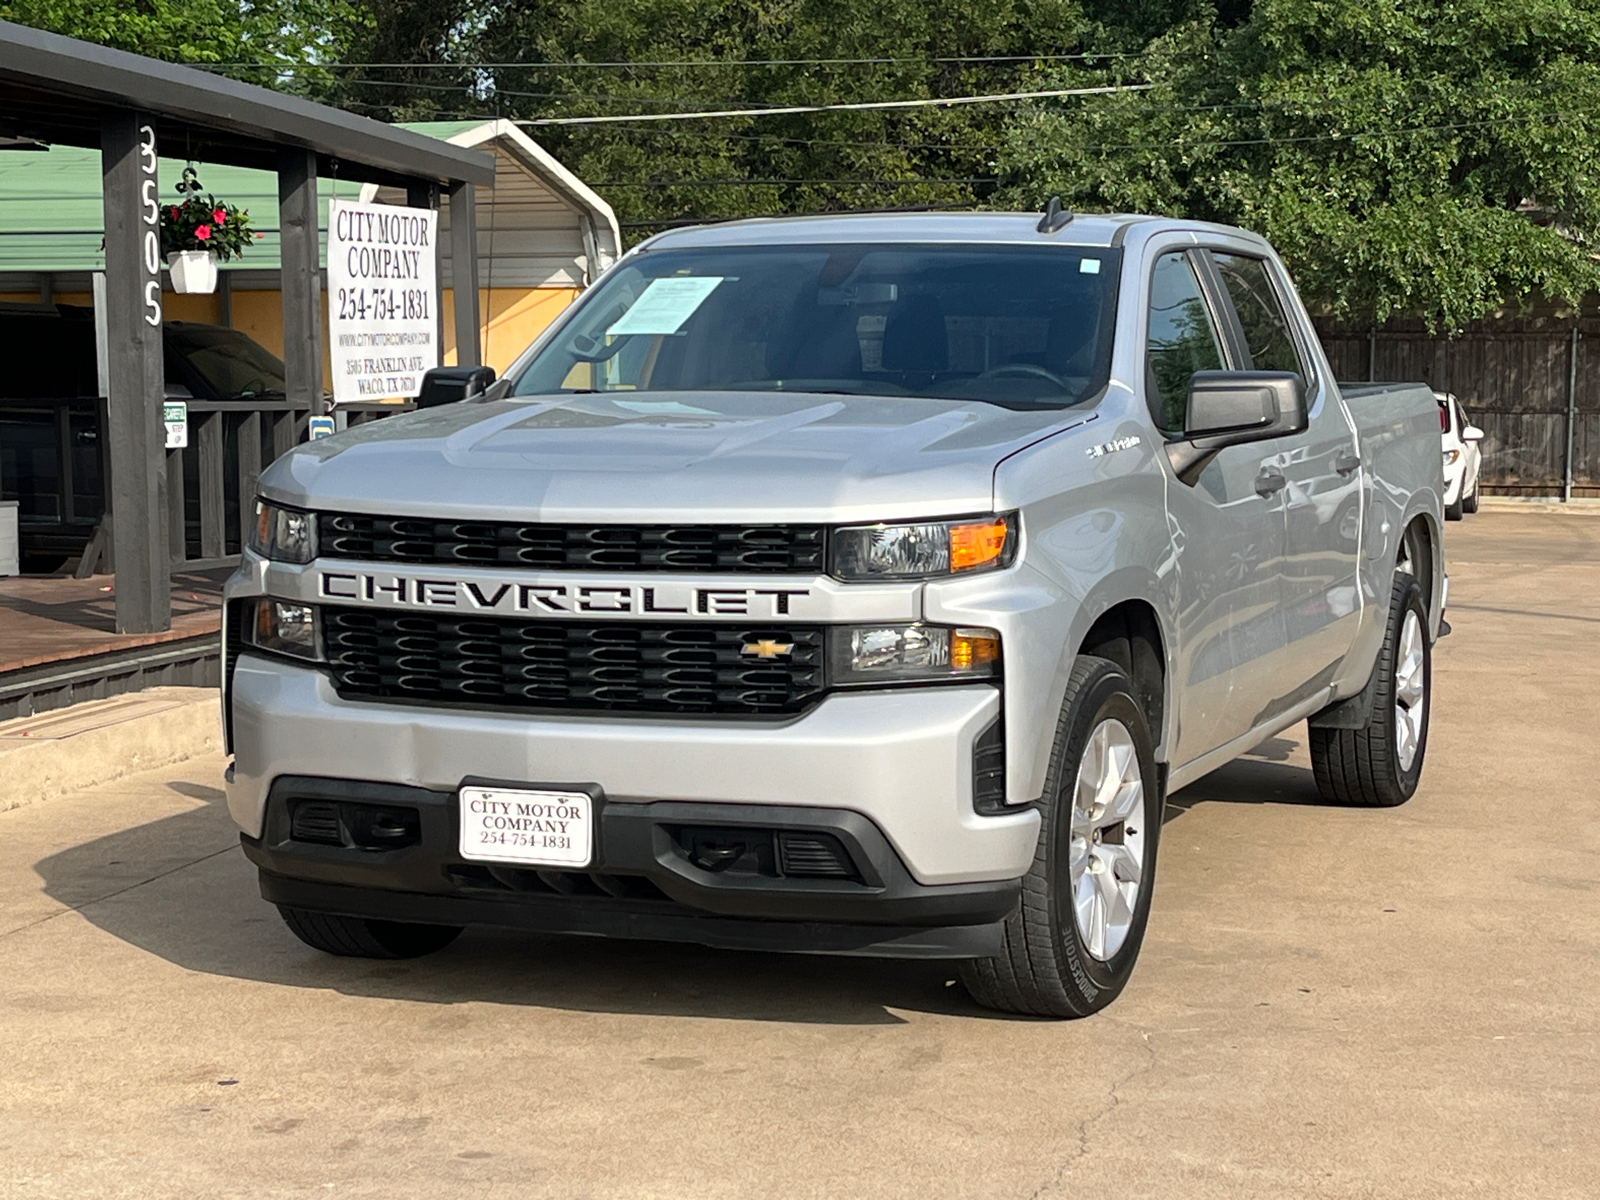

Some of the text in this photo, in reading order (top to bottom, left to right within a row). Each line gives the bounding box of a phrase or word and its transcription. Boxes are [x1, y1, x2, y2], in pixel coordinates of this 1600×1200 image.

[139, 125, 161, 326] 3505
[337, 209, 429, 247] CITY MOTOR
[347, 246, 421, 280] COMPANY
[338, 287, 429, 320] 254-754-1831
[364, 357, 407, 374] FRANKLIN
[357, 378, 385, 395] WACO,
[386, 377, 399, 393] TX
[318, 572, 810, 616] CHEVROLET
[470, 799, 581, 820] CITY MOTOR
[482, 815, 569, 834] COMPANY
[480, 831, 572, 849] 254-754-1831
